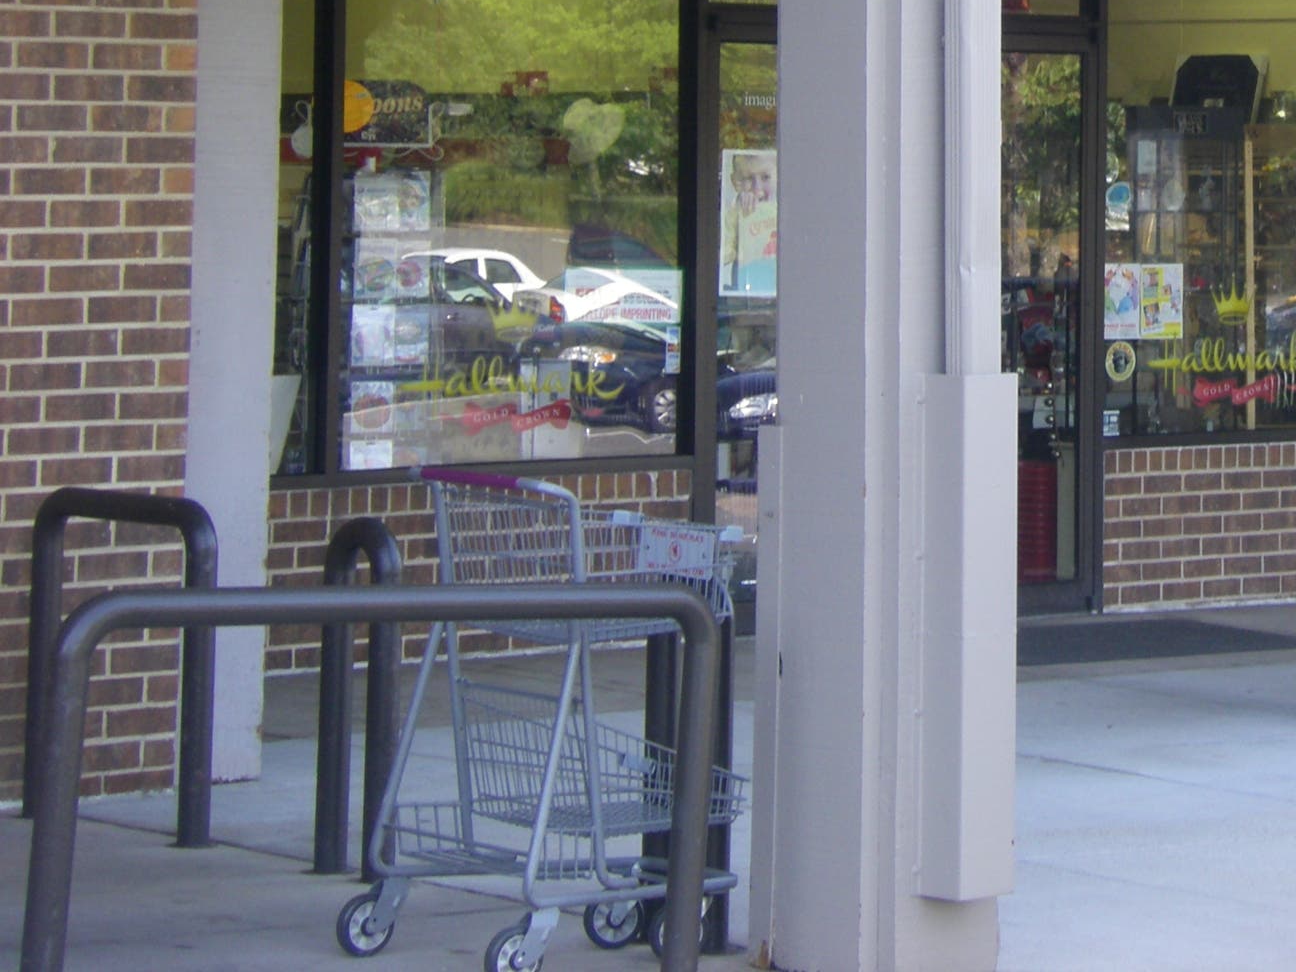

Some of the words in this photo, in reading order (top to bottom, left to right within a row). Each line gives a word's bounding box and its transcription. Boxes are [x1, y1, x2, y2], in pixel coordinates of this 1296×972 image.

[744, 91, 776, 110] imagi
[400, 354, 626, 420] Hallmark
[1203, 383, 1231, 397] GOLD
[472, 408, 509, 422] GOLD
[516, 408, 560, 427] CROWN
